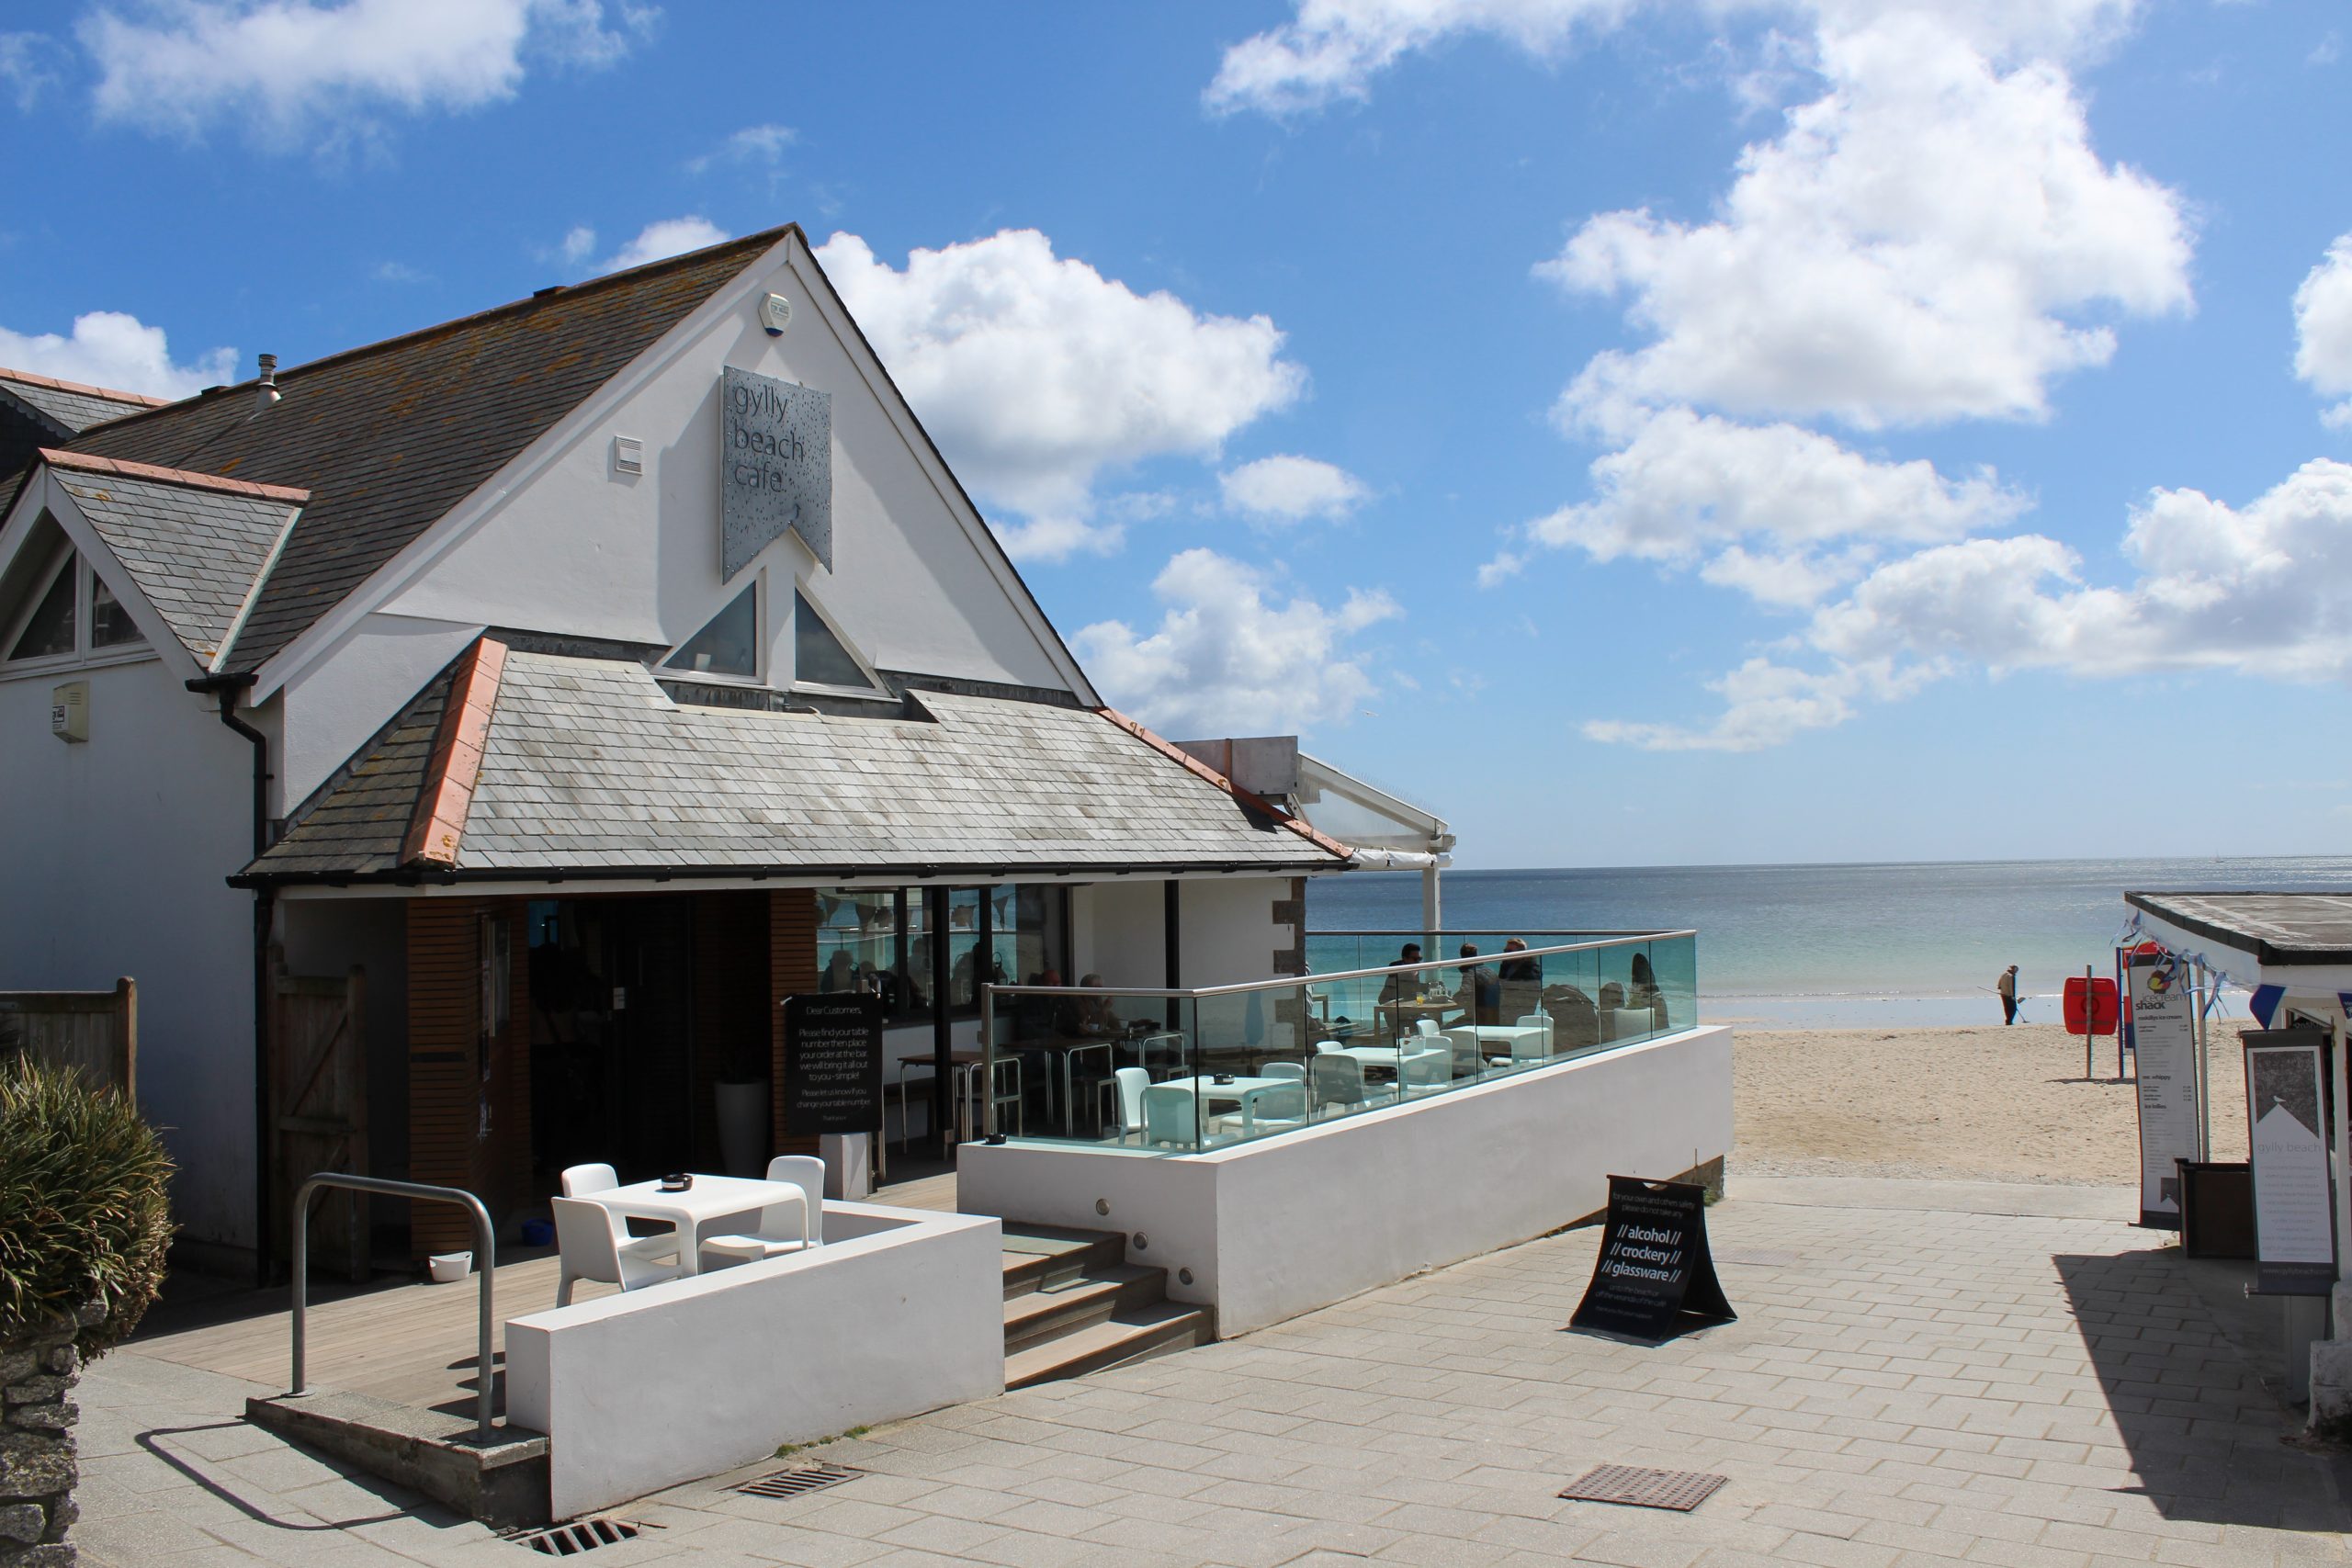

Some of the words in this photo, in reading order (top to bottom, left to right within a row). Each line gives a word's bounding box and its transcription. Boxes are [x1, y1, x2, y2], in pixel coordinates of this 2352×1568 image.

[735, 385, 787, 423] gylly
[735, 419, 804, 462] beach
[735, 461, 782, 492] cafe
[807, 1006, 823, 1015] Dear
[2135, 1000, 2166, 1010] shack
[798, 1028, 820, 1037] Please
[821, 1027, 835, 1037] find
[835, 1029, 851, 1039] your
[852, 1027, 869, 1036] table
[801, 1040, 830, 1048] number
[831, 1039, 847, 1048] then
[848, 1039, 867, 1049] place
[799, 1052, 816, 1061] your
[816, 1050, 835, 1059] order
[842, 1049, 855, 1058] the
[812, 1060, 823, 1070] will
[824, 1060, 842, 1072] bring
[848, 1060, 856, 1069] all
[856, 1061, 868, 1069] out
[808, 1073, 817, 1081] to
[817, 1073, 831, 1083] you
[834, 1088, 852, 1096] know
[855, 1089, 867, 1098] you
[2257, 1142, 2283, 1155] gylly
[2287, 1141, 2322, 1153] beach
[1628, 1225, 1670, 1244] alcohol
[1621, 1246, 1670, 1266] crockery
[1611, 1261, 1669, 1281] glassware
